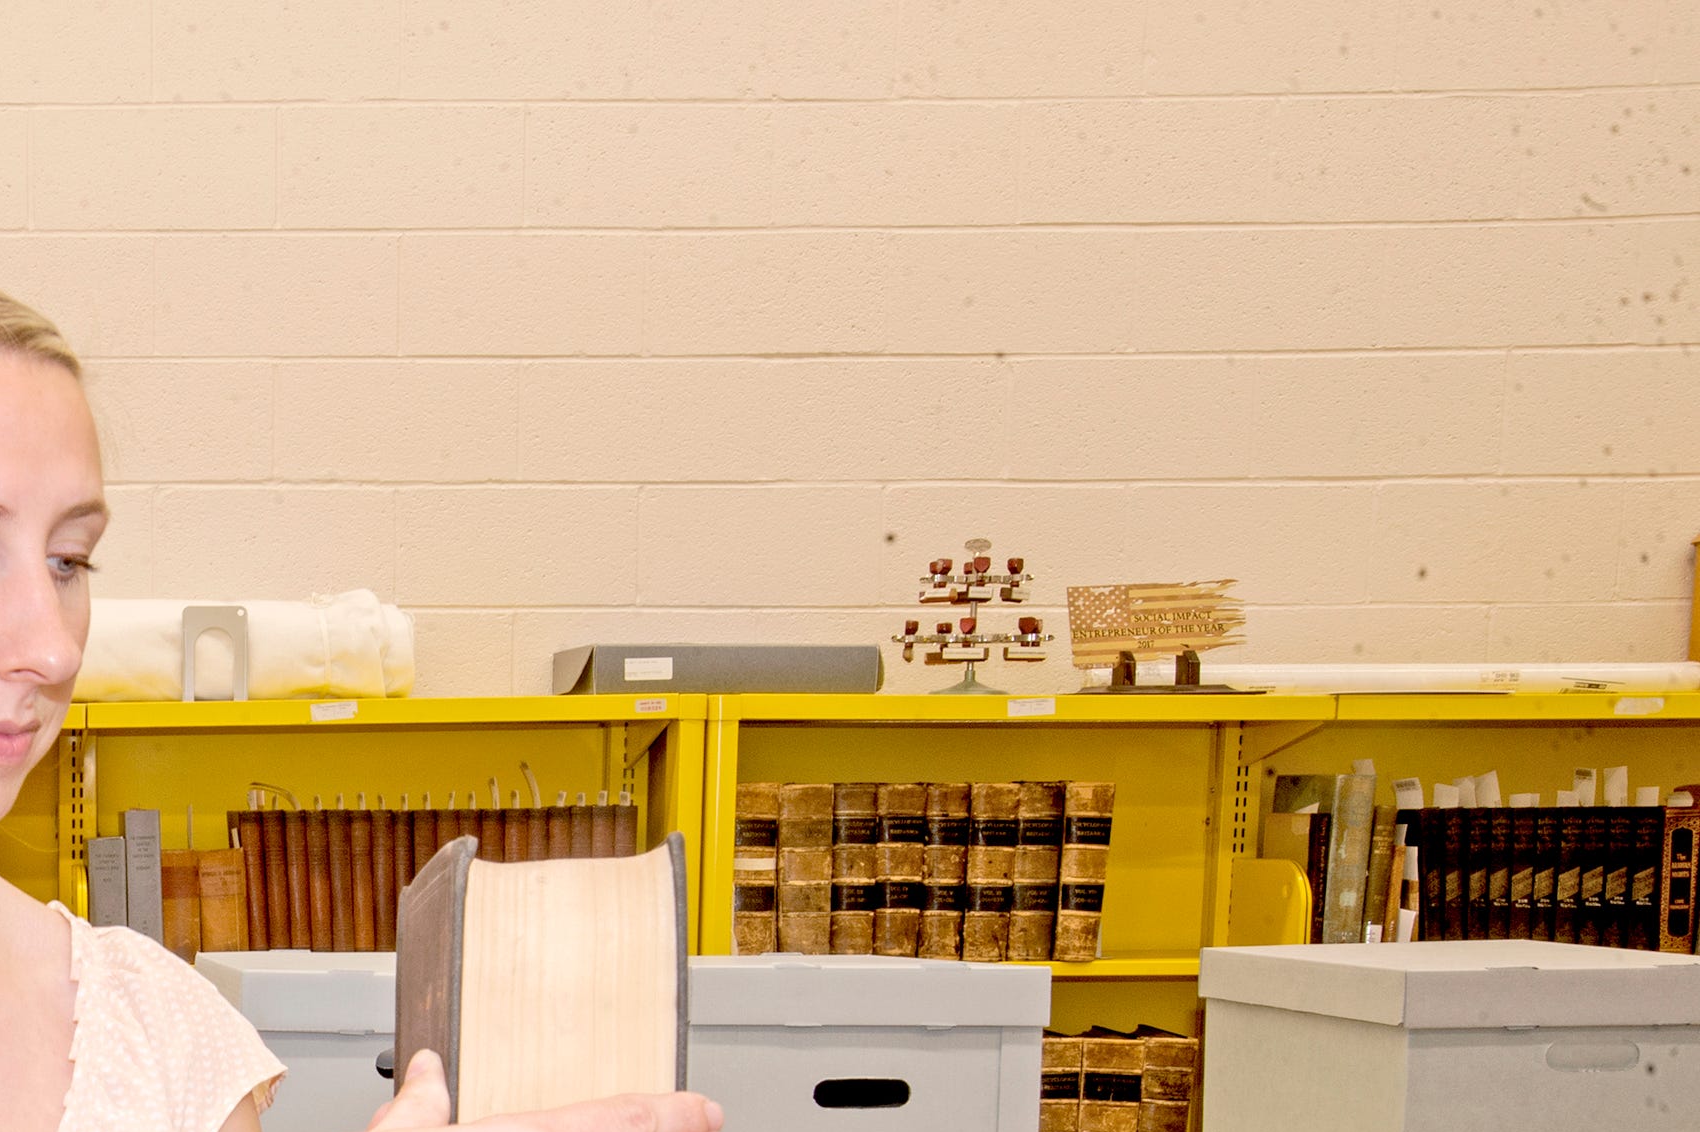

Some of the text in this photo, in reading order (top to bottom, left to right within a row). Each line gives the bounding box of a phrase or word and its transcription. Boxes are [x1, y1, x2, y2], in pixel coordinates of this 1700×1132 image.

[1134, 611, 1212, 623] SOCIAL IMPACT
[1073, 623, 1224, 639] ENTREPRENEUR OF THE YEAR
[1137, 640, 1154, 648] 2017
